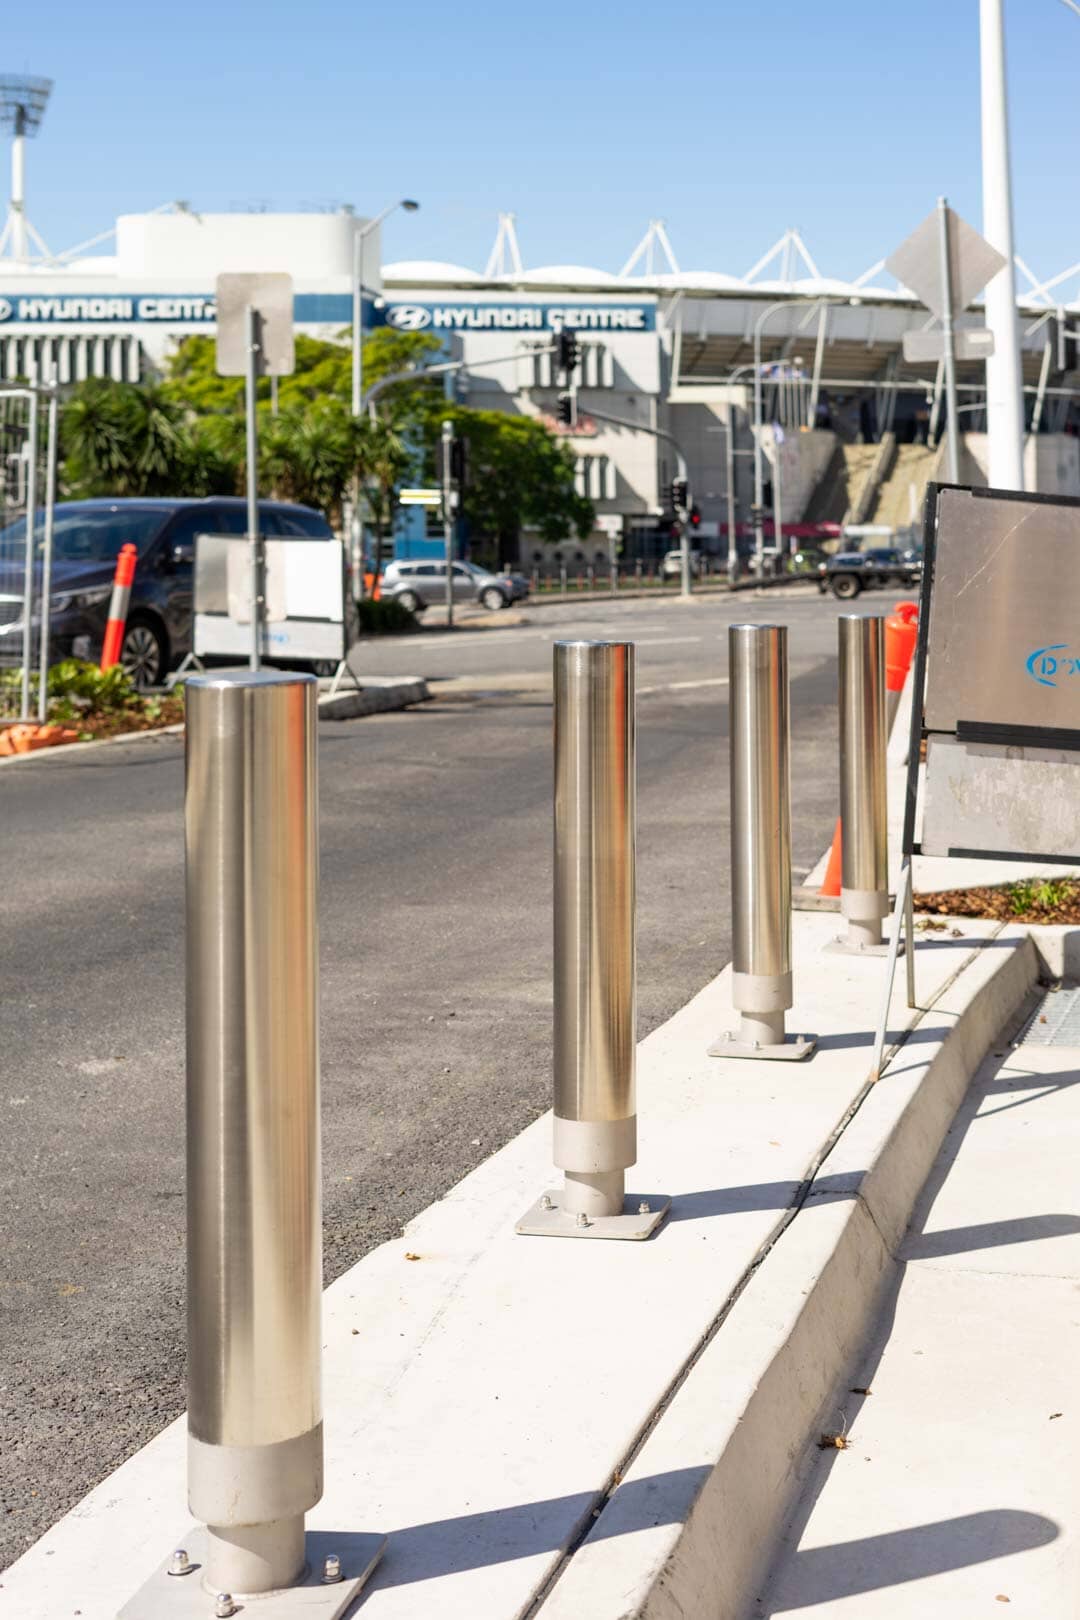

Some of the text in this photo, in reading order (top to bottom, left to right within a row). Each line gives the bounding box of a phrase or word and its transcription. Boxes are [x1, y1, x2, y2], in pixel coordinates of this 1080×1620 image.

[19, 298, 133, 320] HYUNDAI
[432, 308, 646, 329] HYUNDAI CENTRE
